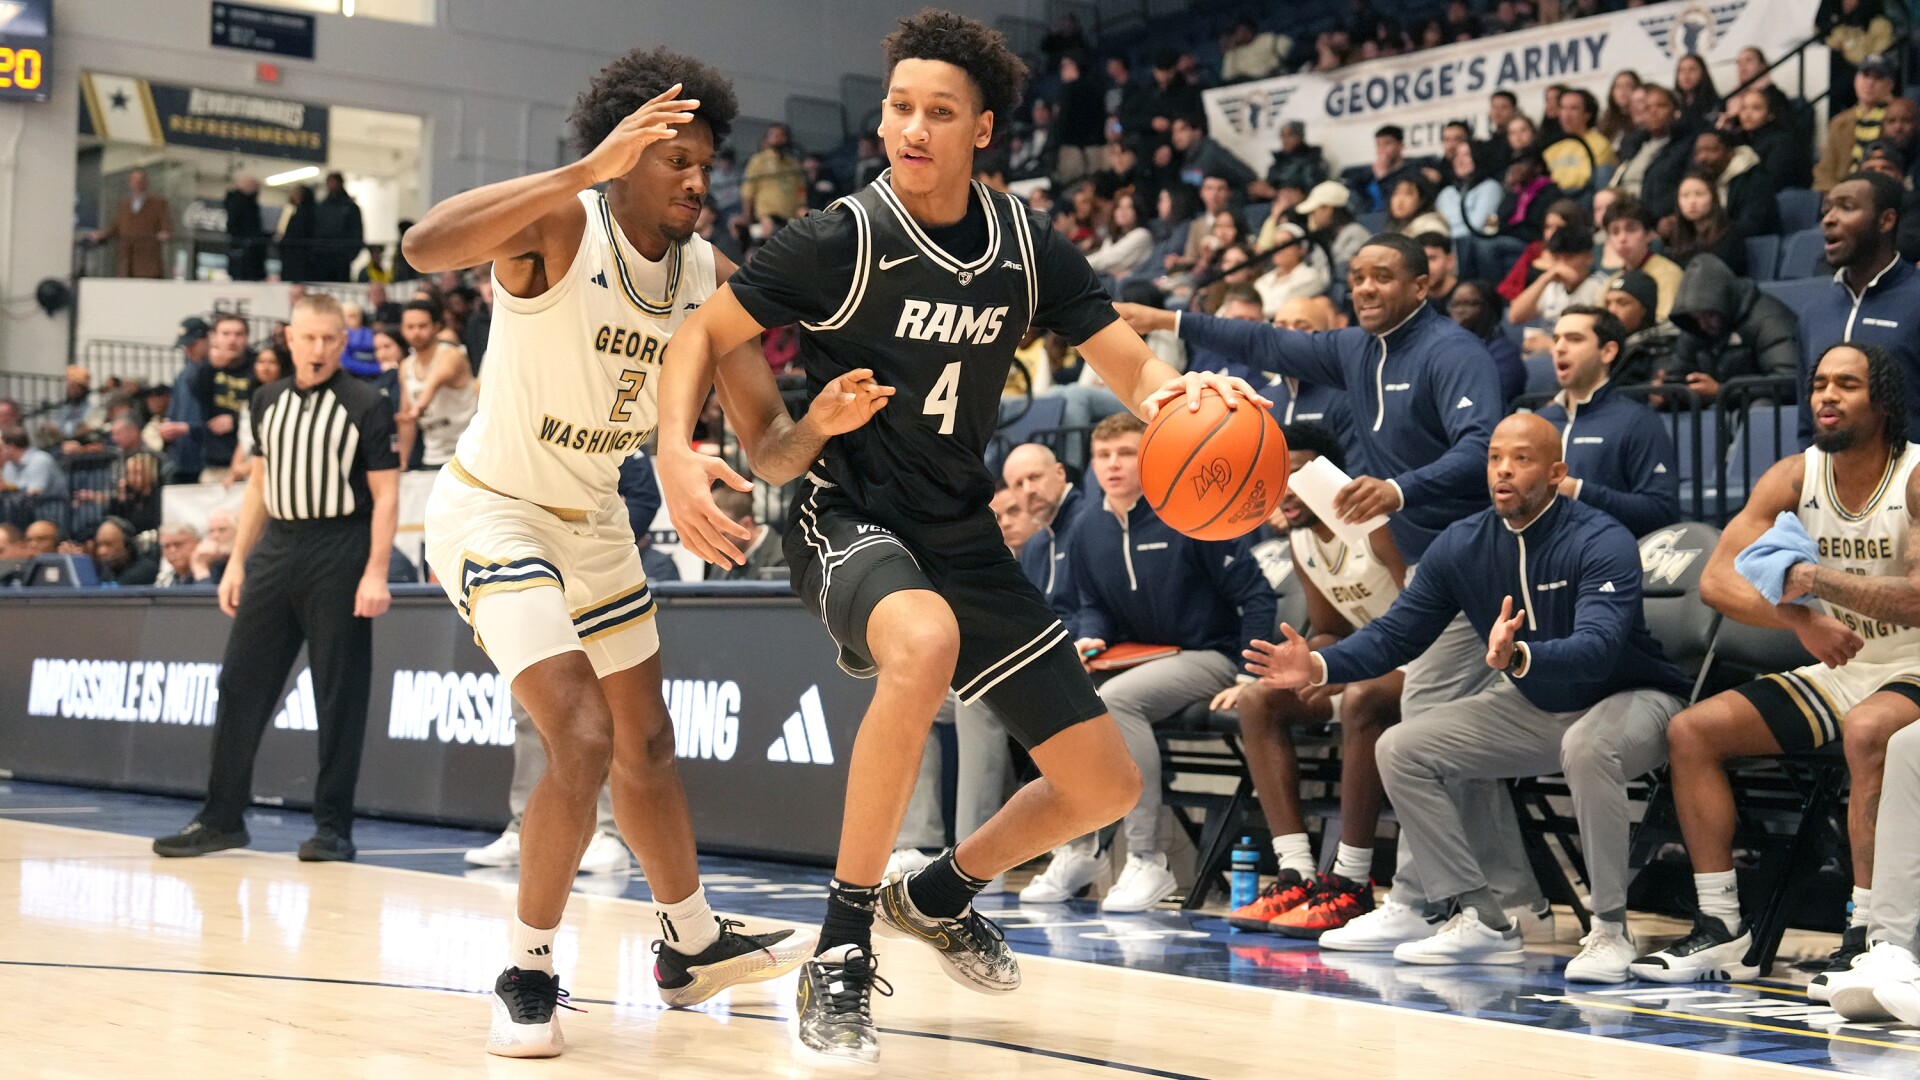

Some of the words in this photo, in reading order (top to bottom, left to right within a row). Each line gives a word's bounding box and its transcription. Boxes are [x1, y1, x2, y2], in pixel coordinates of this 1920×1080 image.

[1325, 56, 1486, 118] GEORGE'S
[1496, 33, 1609, 86] ARMY
[168, 113, 322, 149] REFRESHMENTS
[594, 322, 670, 367] GEOR
[895, 298, 1009, 345] RAMS
[608, 368, 647, 422] 2
[922, 361, 962, 435] 4
[1818, 536, 1892, 560] GEORGE
[28, 657, 143, 722] IMPOSSIBLE
[139, 660, 166, 724] IS
[161, 661, 223, 727] NOTH
[661, 678, 742, 762] HING
